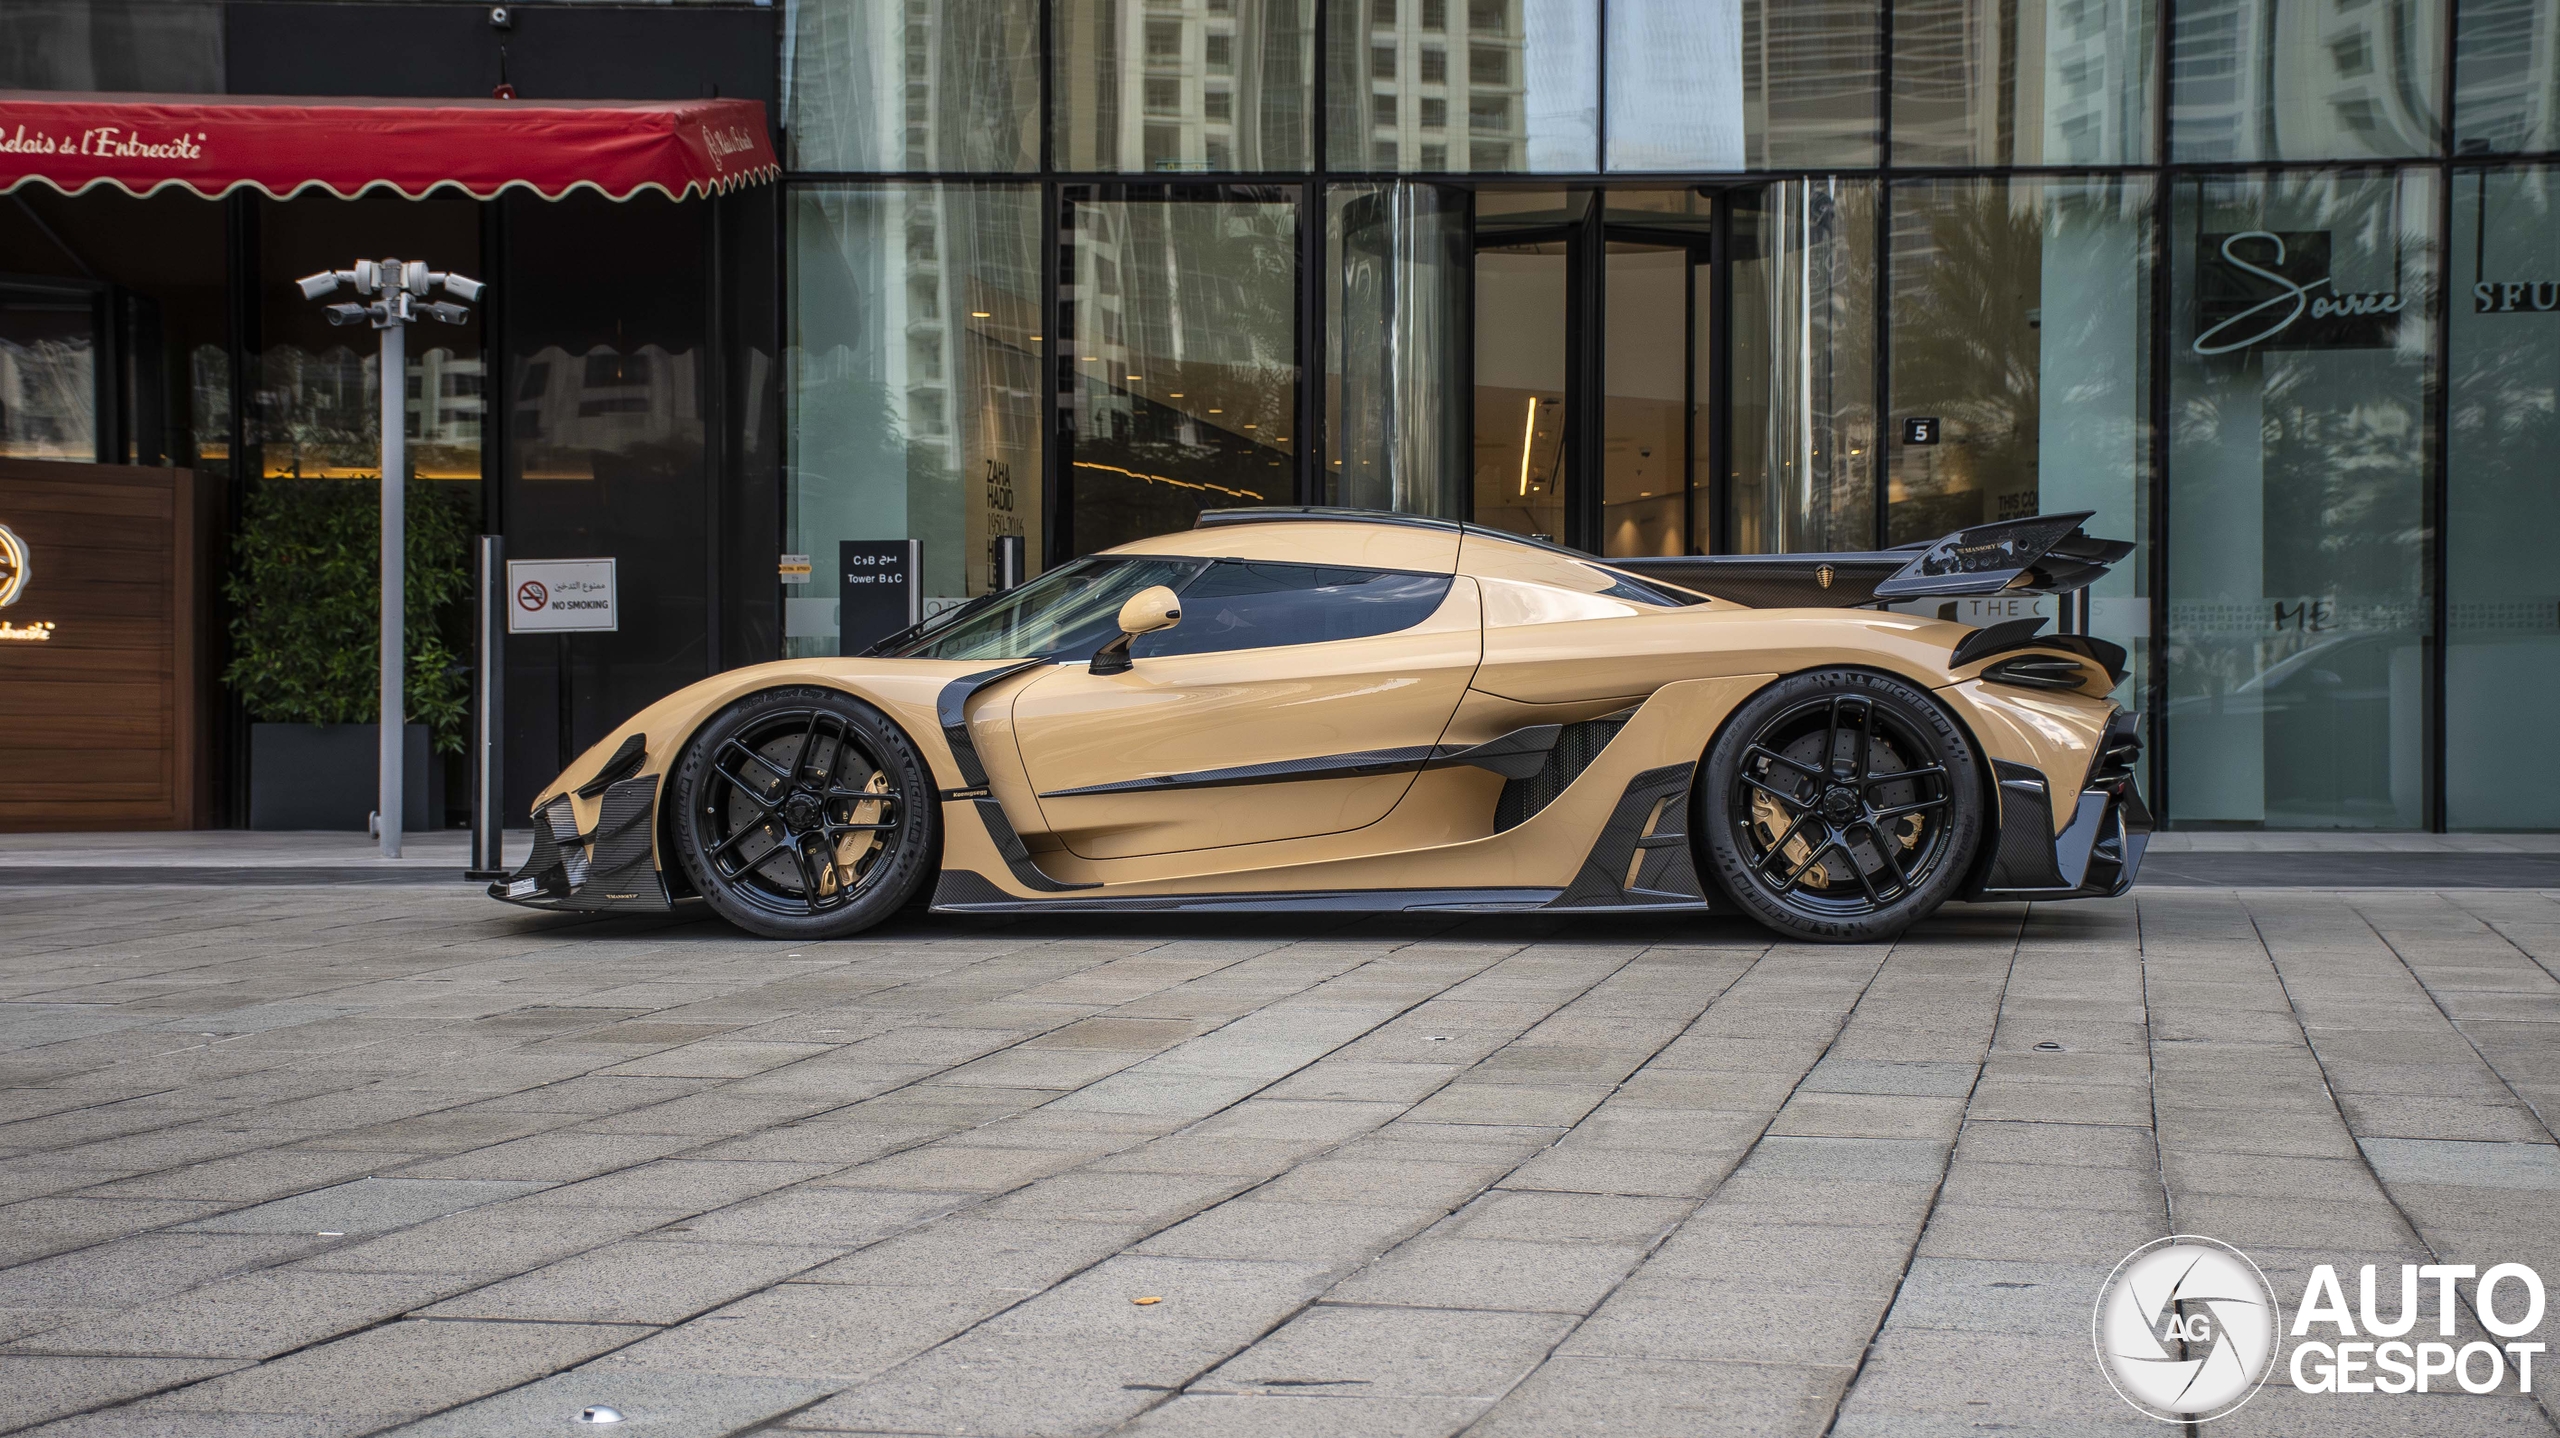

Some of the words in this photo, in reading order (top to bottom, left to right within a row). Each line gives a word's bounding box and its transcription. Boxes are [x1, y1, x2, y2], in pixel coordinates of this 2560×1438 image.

[59, 136, 77, 154] de
[1914, 425, 1927, 441] 5
[987, 459, 1011, 487] ZAHA
[987, 484, 1013, 512] HADID
[1998, 493, 2019, 511] THIS
[2022, 491, 2038, 508] CO
[1964, 543, 1997, 554] MANSORY
[554, 581, 580, 593] التدخين
[582, 582, 606, 593] ممنوع
[848, 574, 875, 583] Tower
[552, 601, 566, 610] NO
[567, 600, 609, 610] SMOKING
[1970, 601, 2018, 616] THE
[2273, 600, 2339, 632] ME
[1867, 675, 1950, 736] MICHELIN
[903, 764, 922, 843] MICHELIN
[678, 778, 694, 856] MICHELIN
[1732, 872, 1815, 932] MICHELIN
